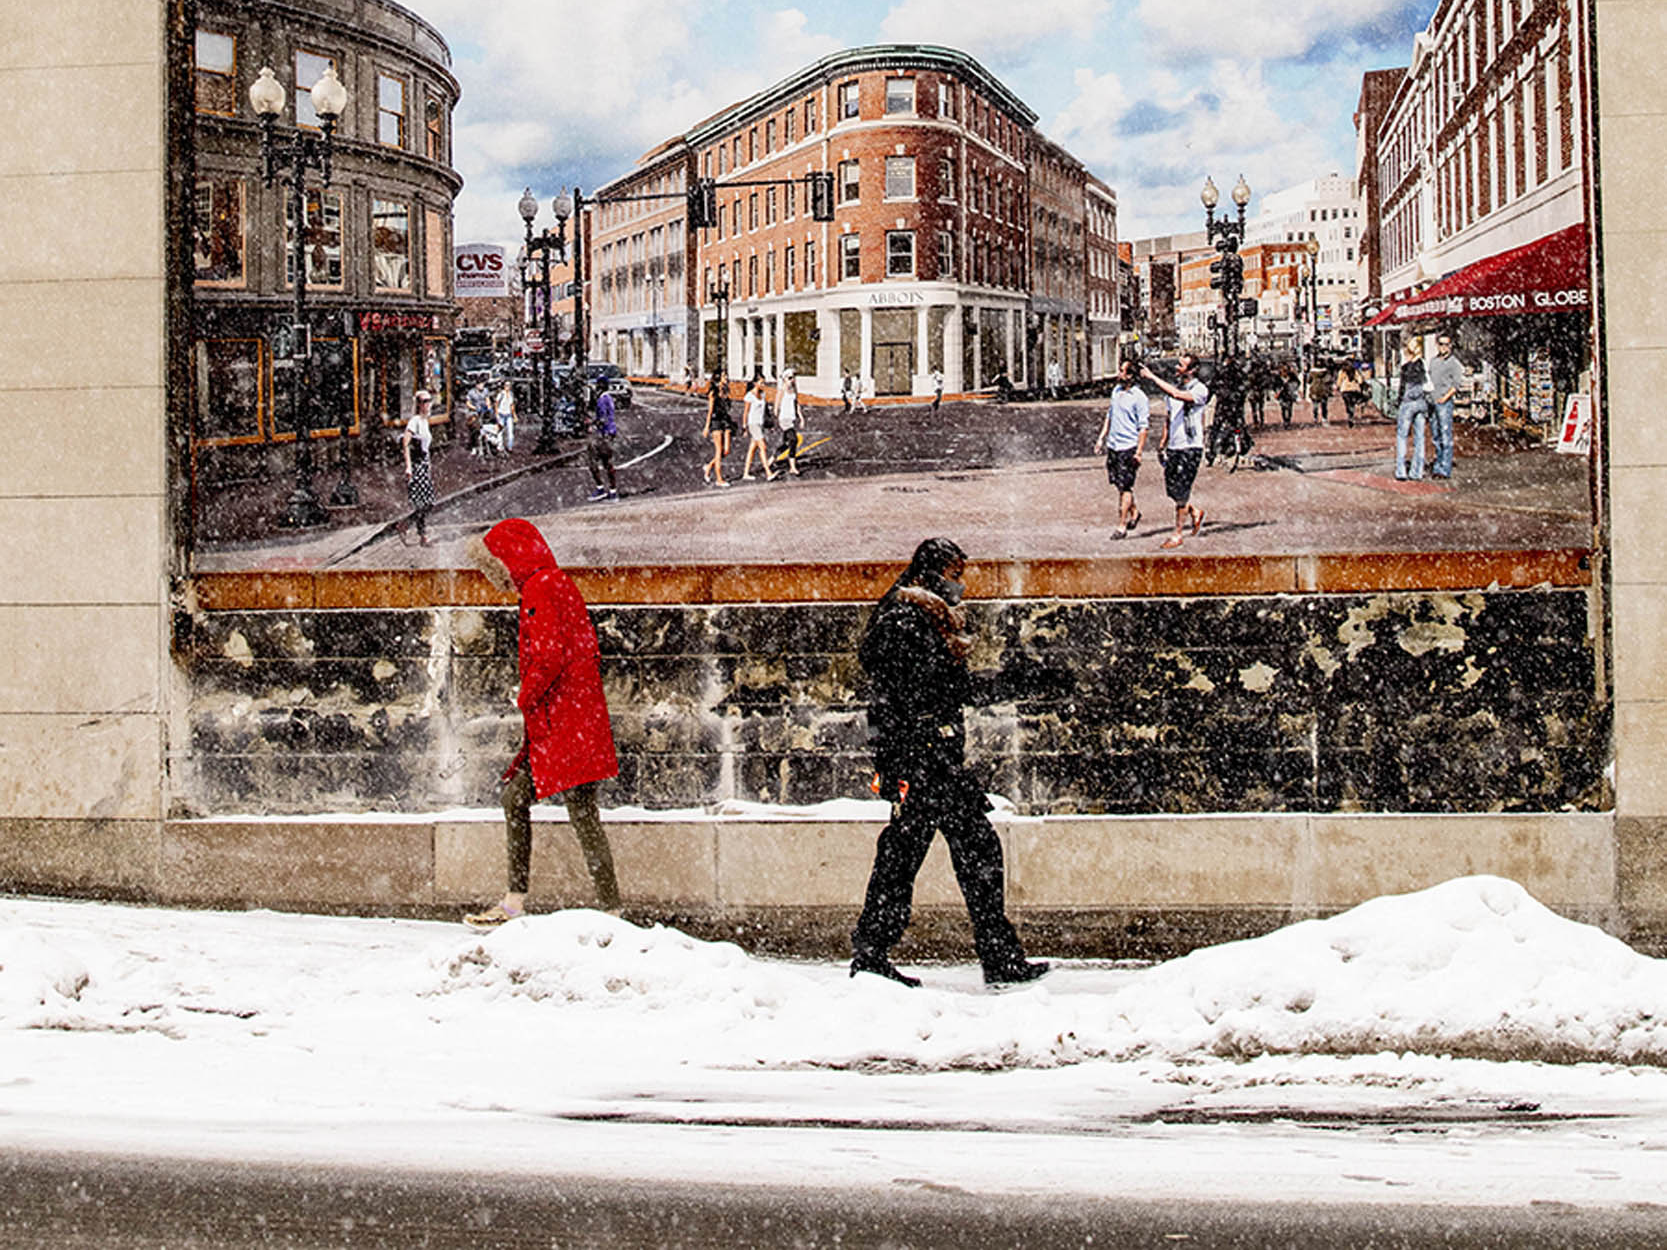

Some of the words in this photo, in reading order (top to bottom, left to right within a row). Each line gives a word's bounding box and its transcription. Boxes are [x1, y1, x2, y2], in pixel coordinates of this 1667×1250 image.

[456, 253, 503, 271] CVS
[1469, 293, 1525, 311] BOSTON
[1534, 289, 1588, 307] GLOBE
